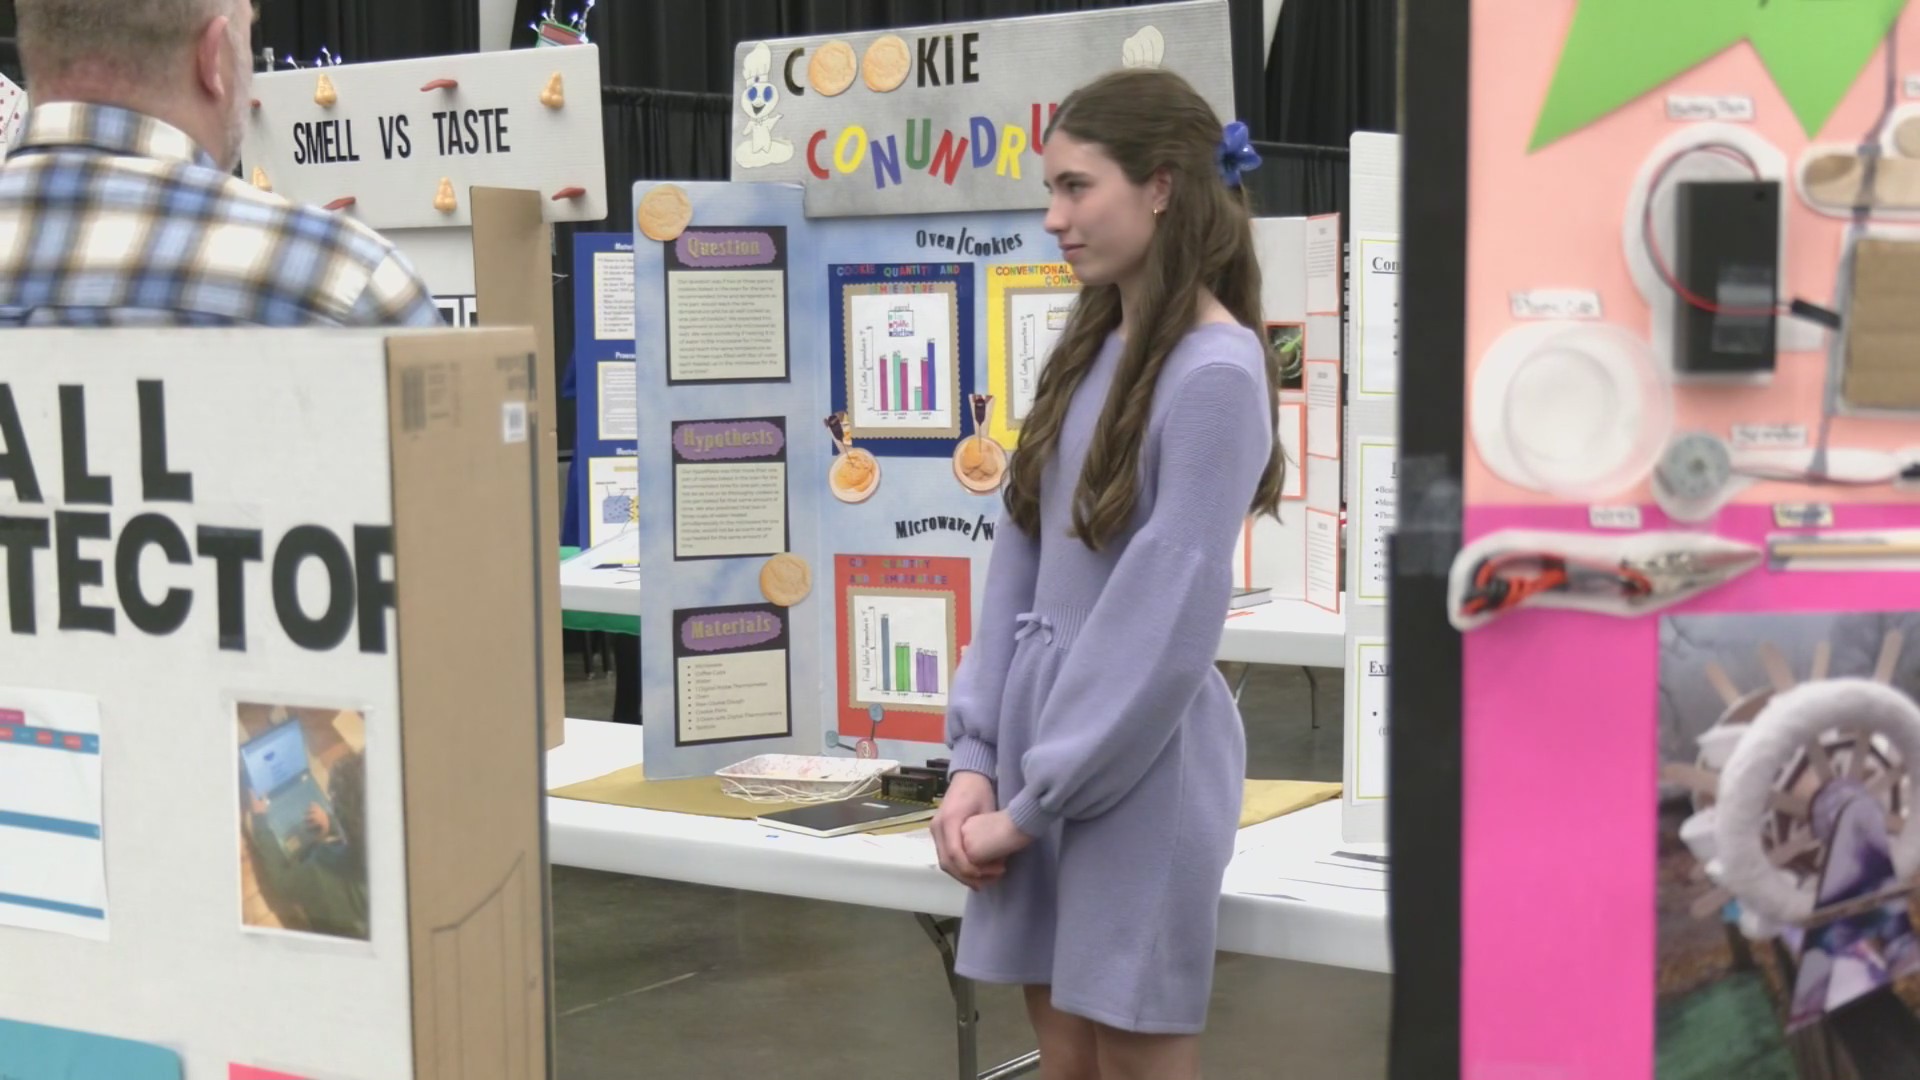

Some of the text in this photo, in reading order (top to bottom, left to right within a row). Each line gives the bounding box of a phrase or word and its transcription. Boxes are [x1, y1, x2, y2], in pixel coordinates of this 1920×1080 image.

[293, 107, 511, 164] SMELL VS TASTE
[687, 238, 761, 259] Question
[996, 264, 1070, 276] CONVENTIONAL
[684, 428, 775, 452] Hypothesis
[691, 615, 771, 639] Materials
